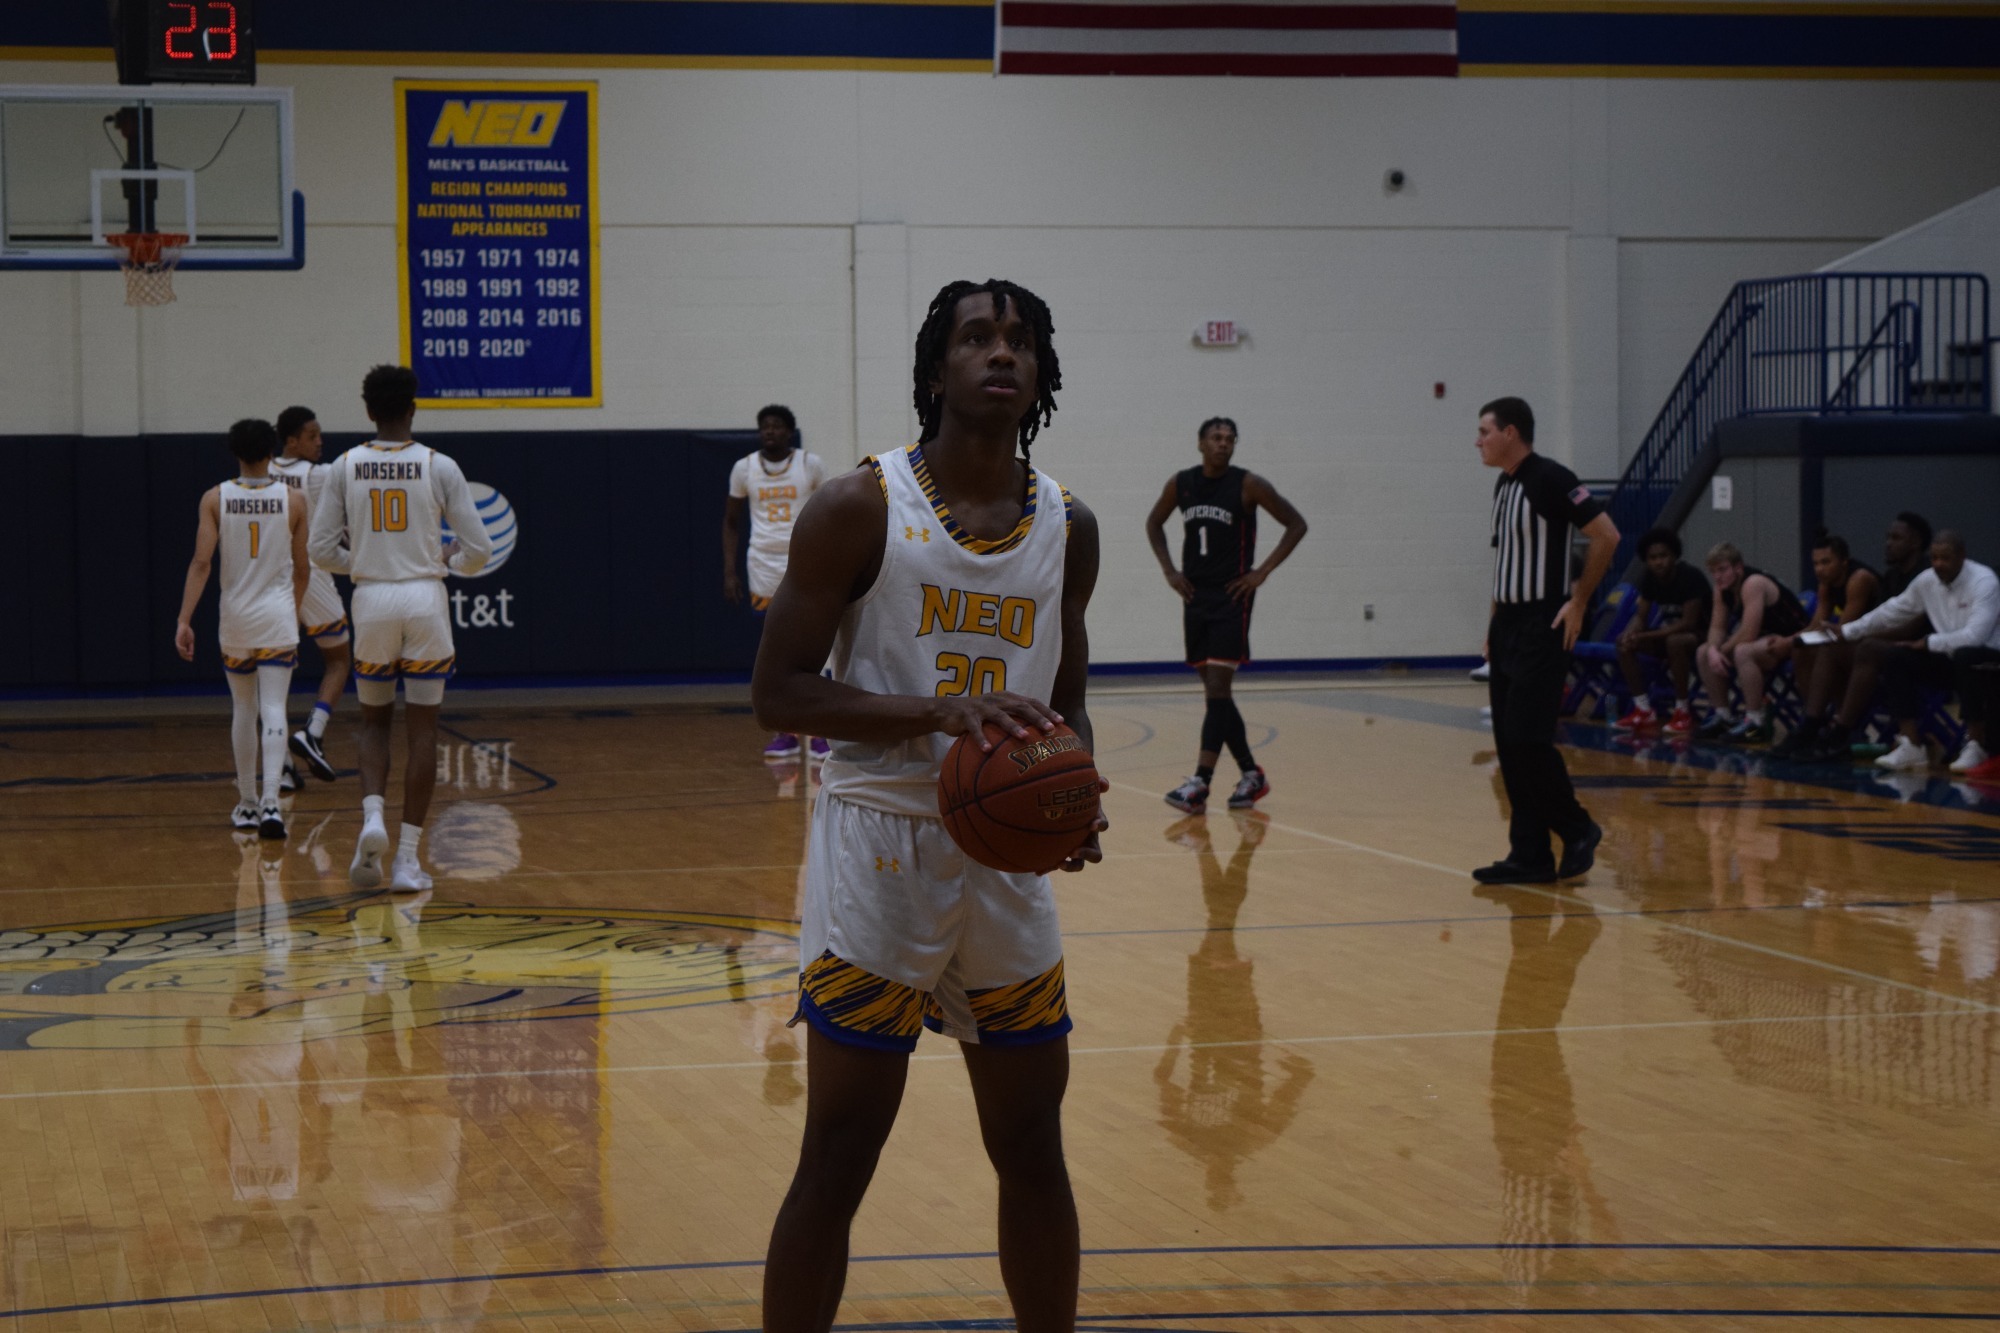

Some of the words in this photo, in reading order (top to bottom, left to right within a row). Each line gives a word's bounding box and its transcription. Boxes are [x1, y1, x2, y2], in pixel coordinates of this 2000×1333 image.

[164, 2, 237, 60] 23
[427, 99, 568, 148] NEO
[427, 158, 476, 172] MEN'S
[479, 159, 570, 173] BASKETBALL
[431, 181, 481, 197] REGION
[485, 181, 568, 198] CHAMPIONS
[417, 203, 484, 219] NATIONAL
[488, 203, 582, 219] TOURNAMENT
[451, 221, 548, 237] APPEARANCES
[420, 248, 466, 268] 1957
[477, 248, 523, 268] 1971
[534, 248, 580, 268] 1974
[421, 278, 468, 298] 1989
[477, 278, 523, 298] 1991
[534, 278, 580, 298] 1992
[421, 308, 469, 328] 2008
[478, 308, 525, 328] 2014
[536, 308, 582, 328] 2016
[423, 338, 470, 358] 2019
[355, 462, 422, 480] NORSEMEN
[225, 498, 283, 514] NORSEMEN
[369, 489, 408, 532] 10
[249, 521, 259, 559] 1
[1198, 526, 1208, 556] 1
[449, 588, 515, 629] t&t
[915, 583, 1036, 649] NEO
[935, 651, 1007, 698] 20
[1036, 781, 1098, 808] LEGAC
